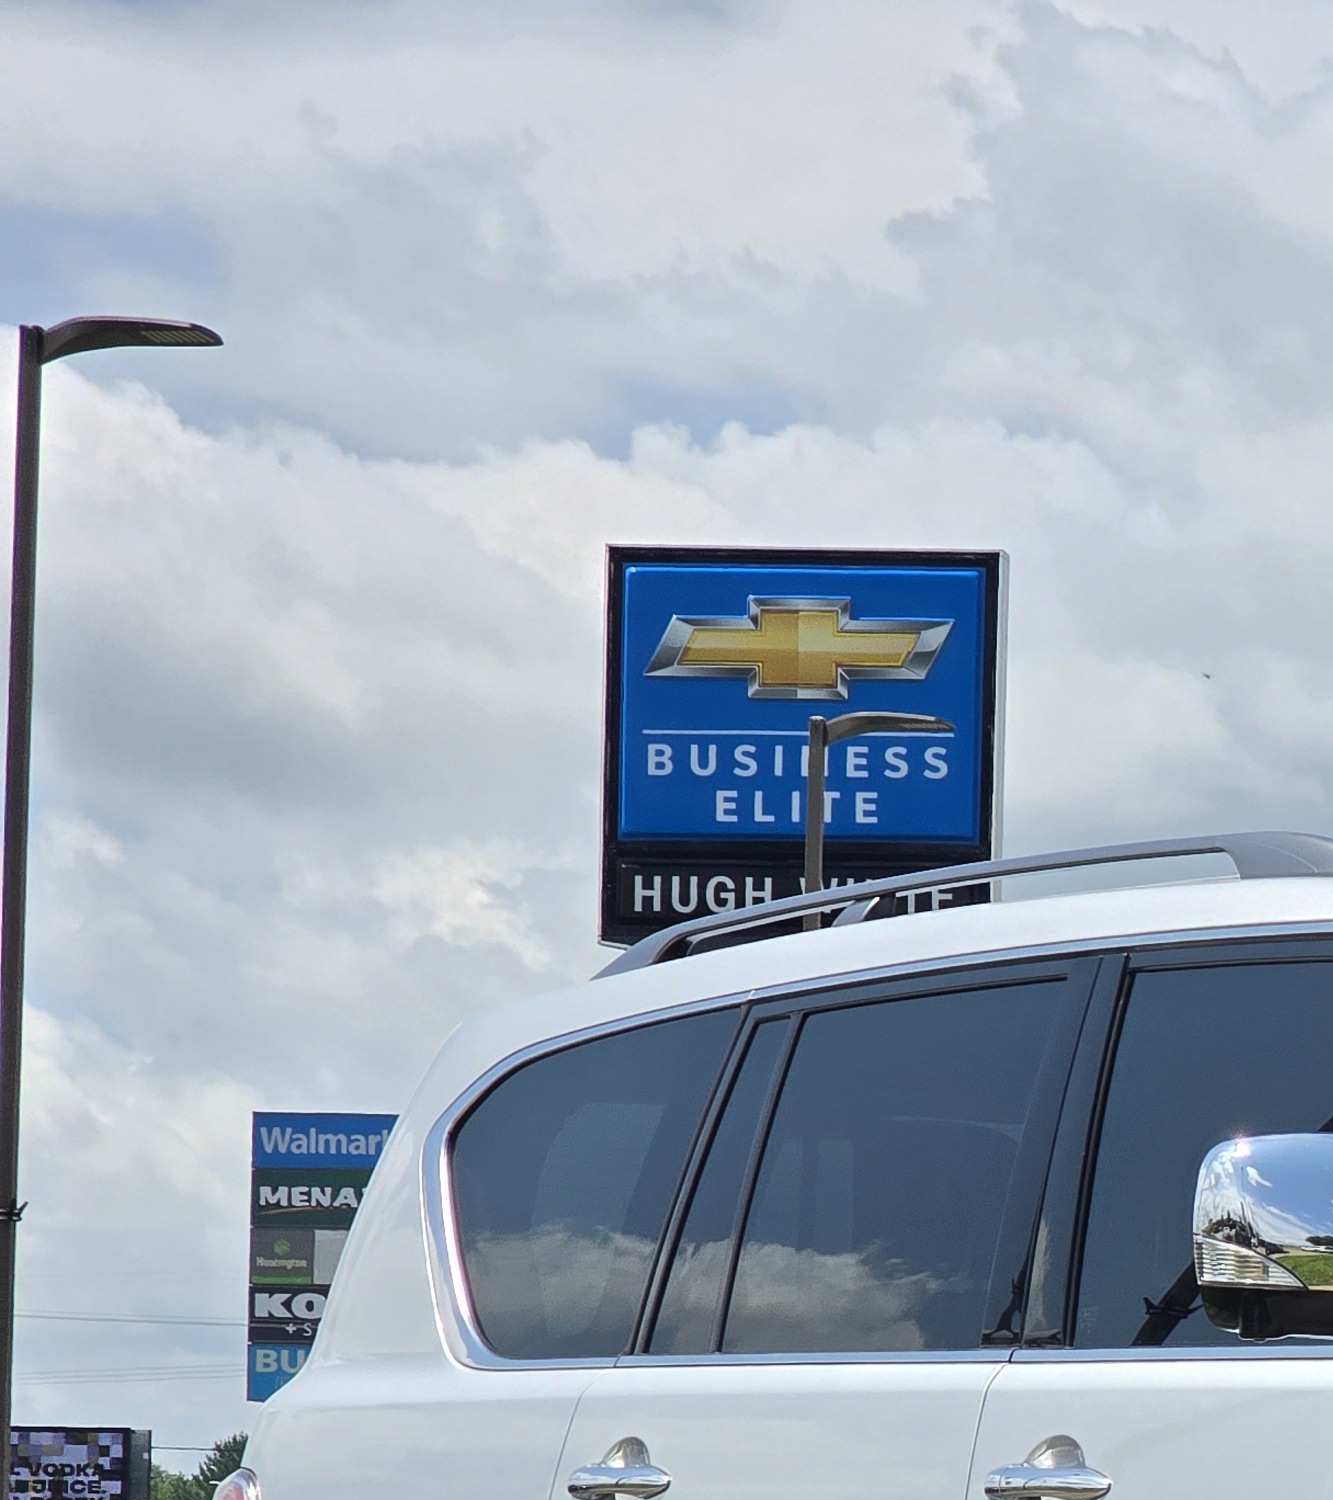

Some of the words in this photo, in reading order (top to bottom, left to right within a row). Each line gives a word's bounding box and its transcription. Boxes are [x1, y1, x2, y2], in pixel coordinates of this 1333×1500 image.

[715, 789, 879, 824] ELITE
[633, 875, 773, 914] HUGH
[258, 1185, 368, 1208] MENA
